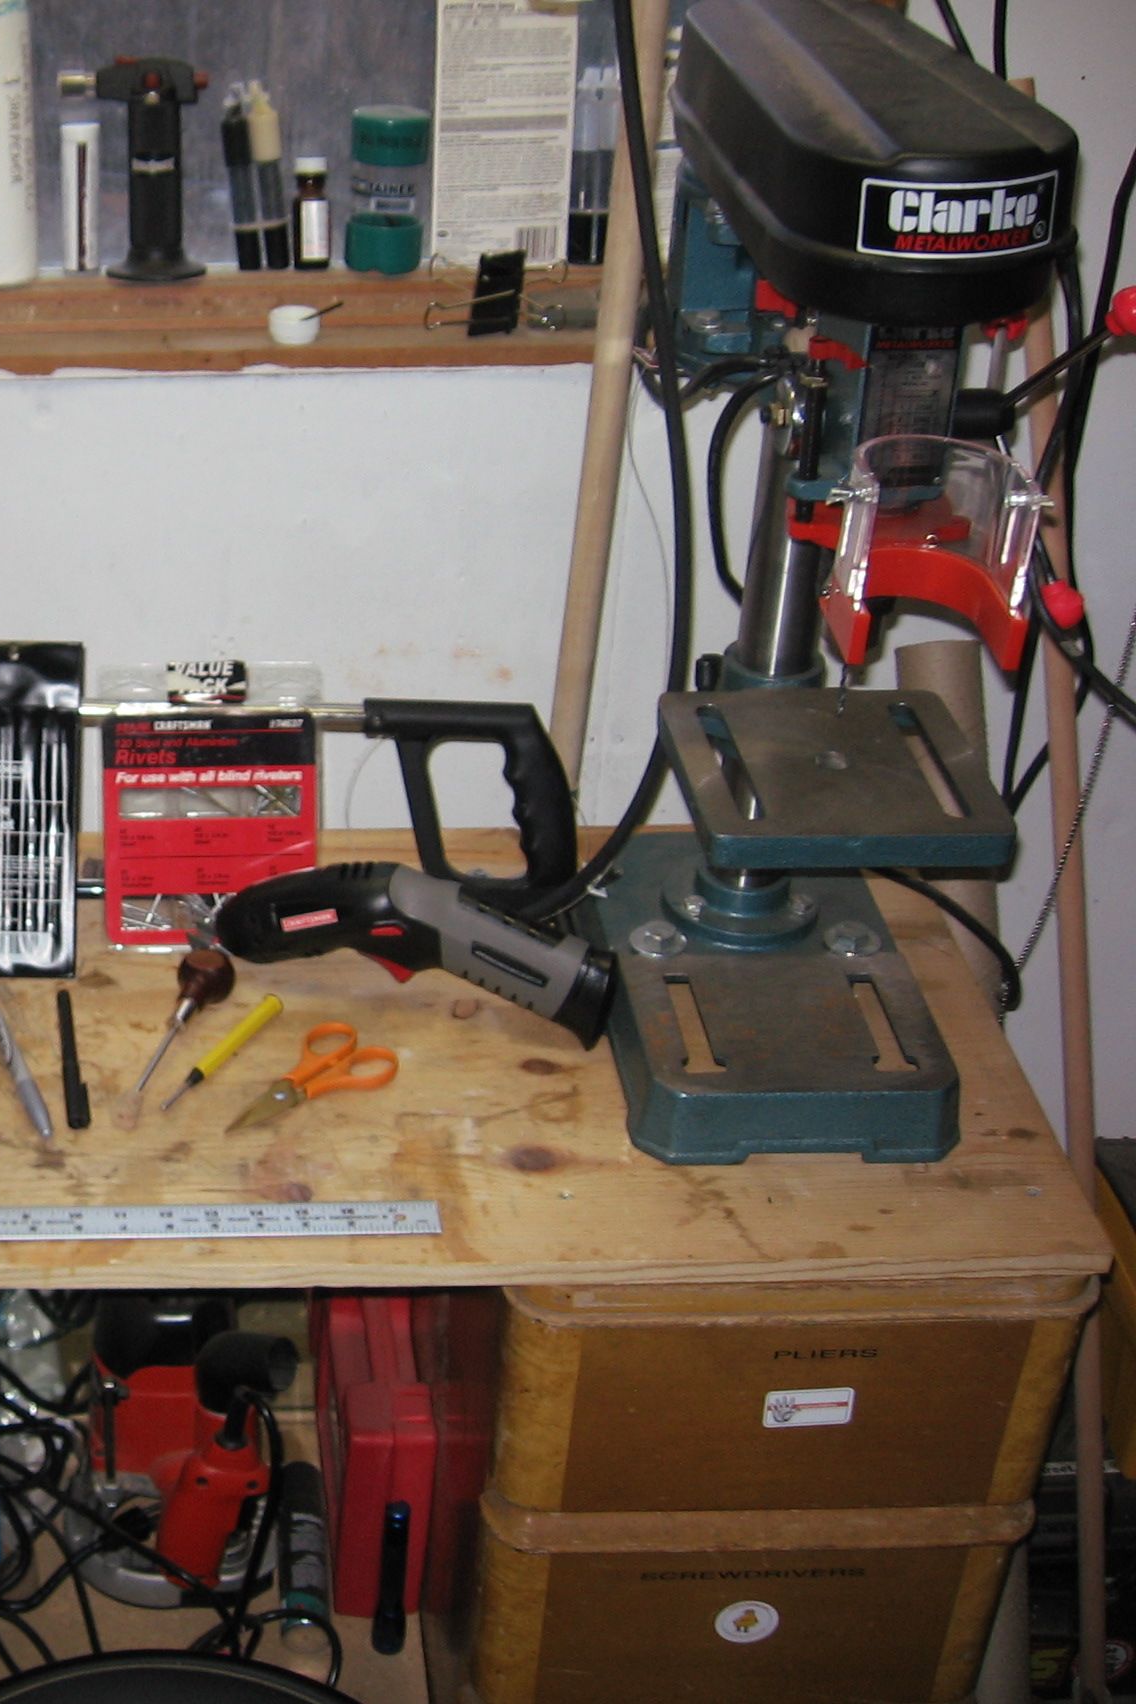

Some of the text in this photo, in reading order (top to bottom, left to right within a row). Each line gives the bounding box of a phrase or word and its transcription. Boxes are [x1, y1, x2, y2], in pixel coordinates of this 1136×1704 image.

[887, 188, 1038, 233] Clarke
[894, 228, 1030, 250] METALWORKER
[175, 660, 235, 676] VALUE
[153, 719, 212, 731] CRAFTSMAN
[115, 749, 177, 766] Rivets
[115, 771, 139, 783] For
[141, 773, 166, 783] use
[168, 770, 197, 782] with
[199, 770, 215, 782] all
[217, 769, 252, 782] blind
[772, 1348, 879, 1360] PLIERS
[639, 1567, 866, 1582] SCREWDRIVERS
